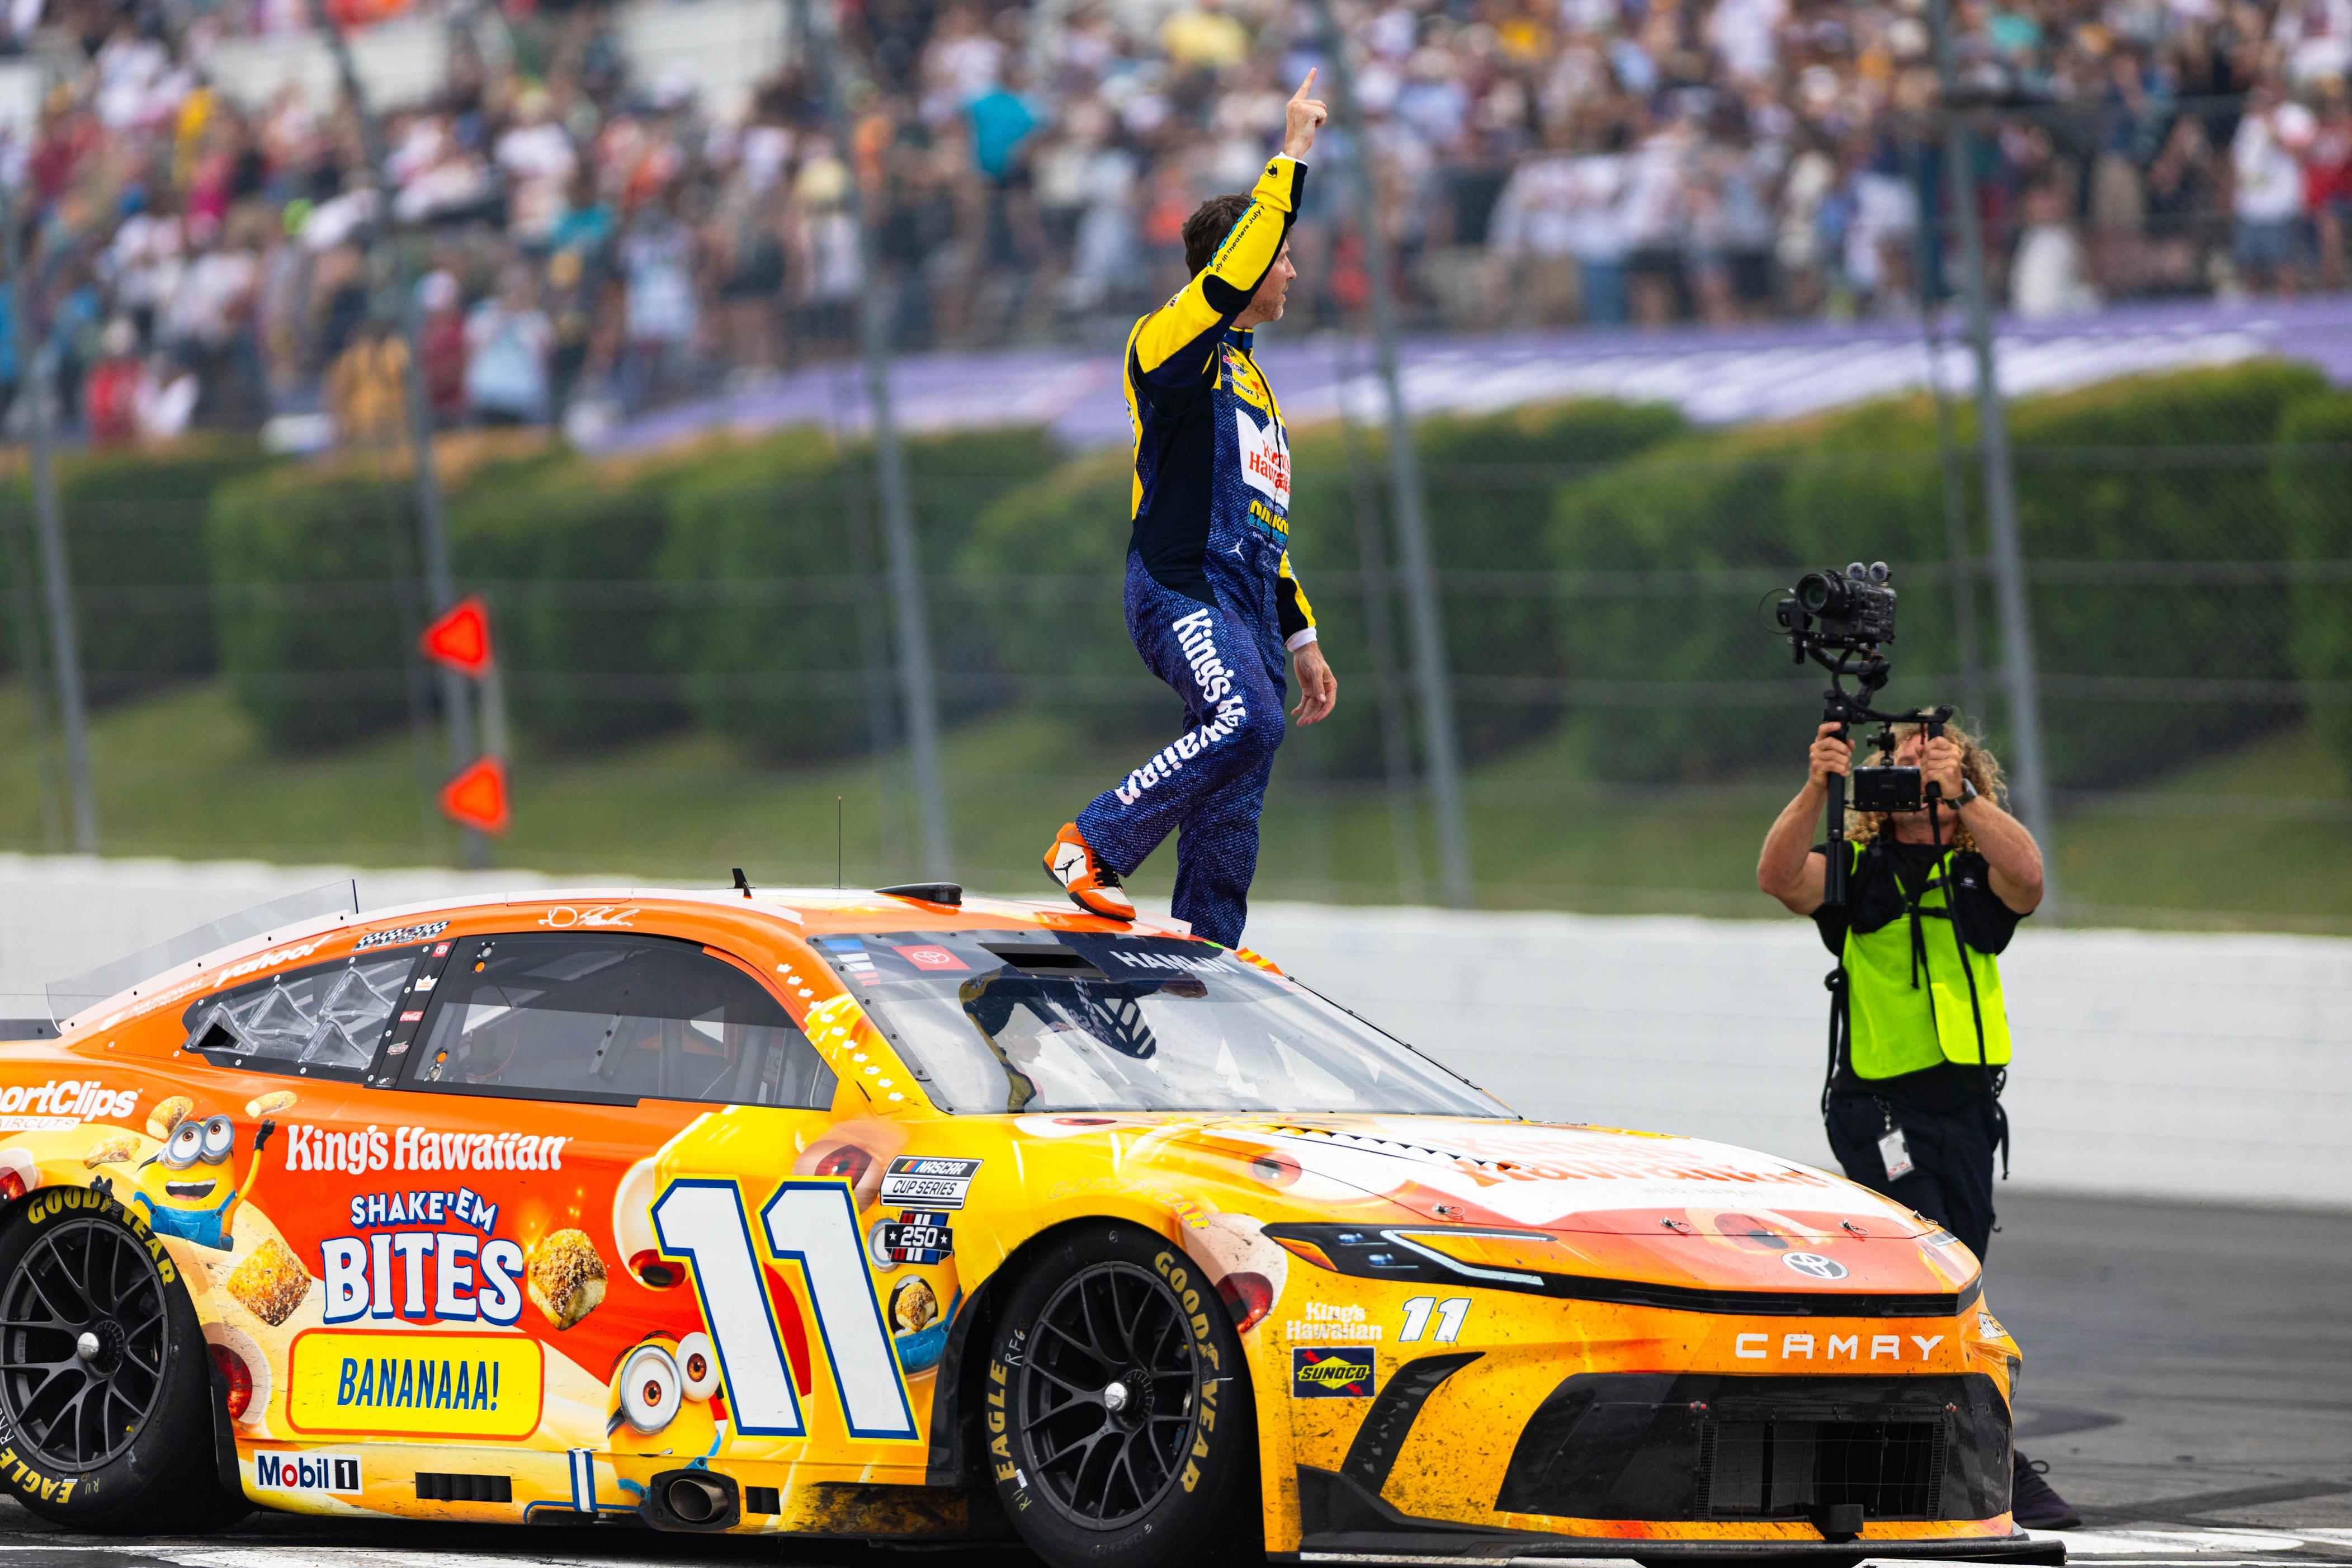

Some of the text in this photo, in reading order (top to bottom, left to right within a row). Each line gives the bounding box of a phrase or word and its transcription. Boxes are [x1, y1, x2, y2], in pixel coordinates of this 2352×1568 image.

[1249, 209, 1262, 225] July
[1114, 607, 1246, 805] King's Hawaiian
[212, 934, 334, 988] yahoo!
[1109, 950, 1240, 974] HAMLIN
[0, 1080, 139, 1122] ortClips
[286, 1125, 565, 1175] King's Hawaiian
[915, 1160, 968, 1176] NASCAR
[892, 1179, 958, 1196] CUP SERIES
[351, 1187, 498, 1238] SHAKE'EM
[899, 1226, 939, 1248] 250
[321, 1230, 525, 1327] BITES
[649, 1174, 924, 1446] 11
[1286, 1319, 1383, 1340] Hawaiian
[1305, 1301, 1366, 1324] King's
[1398, 1295, 1472, 1343] 11
[1734, 1333, 1945, 1361] CAMRY
[337, 1357, 499, 1411] BANANAAA!
[1301, 1366, 1367, 1380] SUNOCO
[988, 1358, 1018, 1482] EAGLE
[0, 1447, 78, 1503] EAGLE
[258, 1455, 351, 1489] Mobil 1
